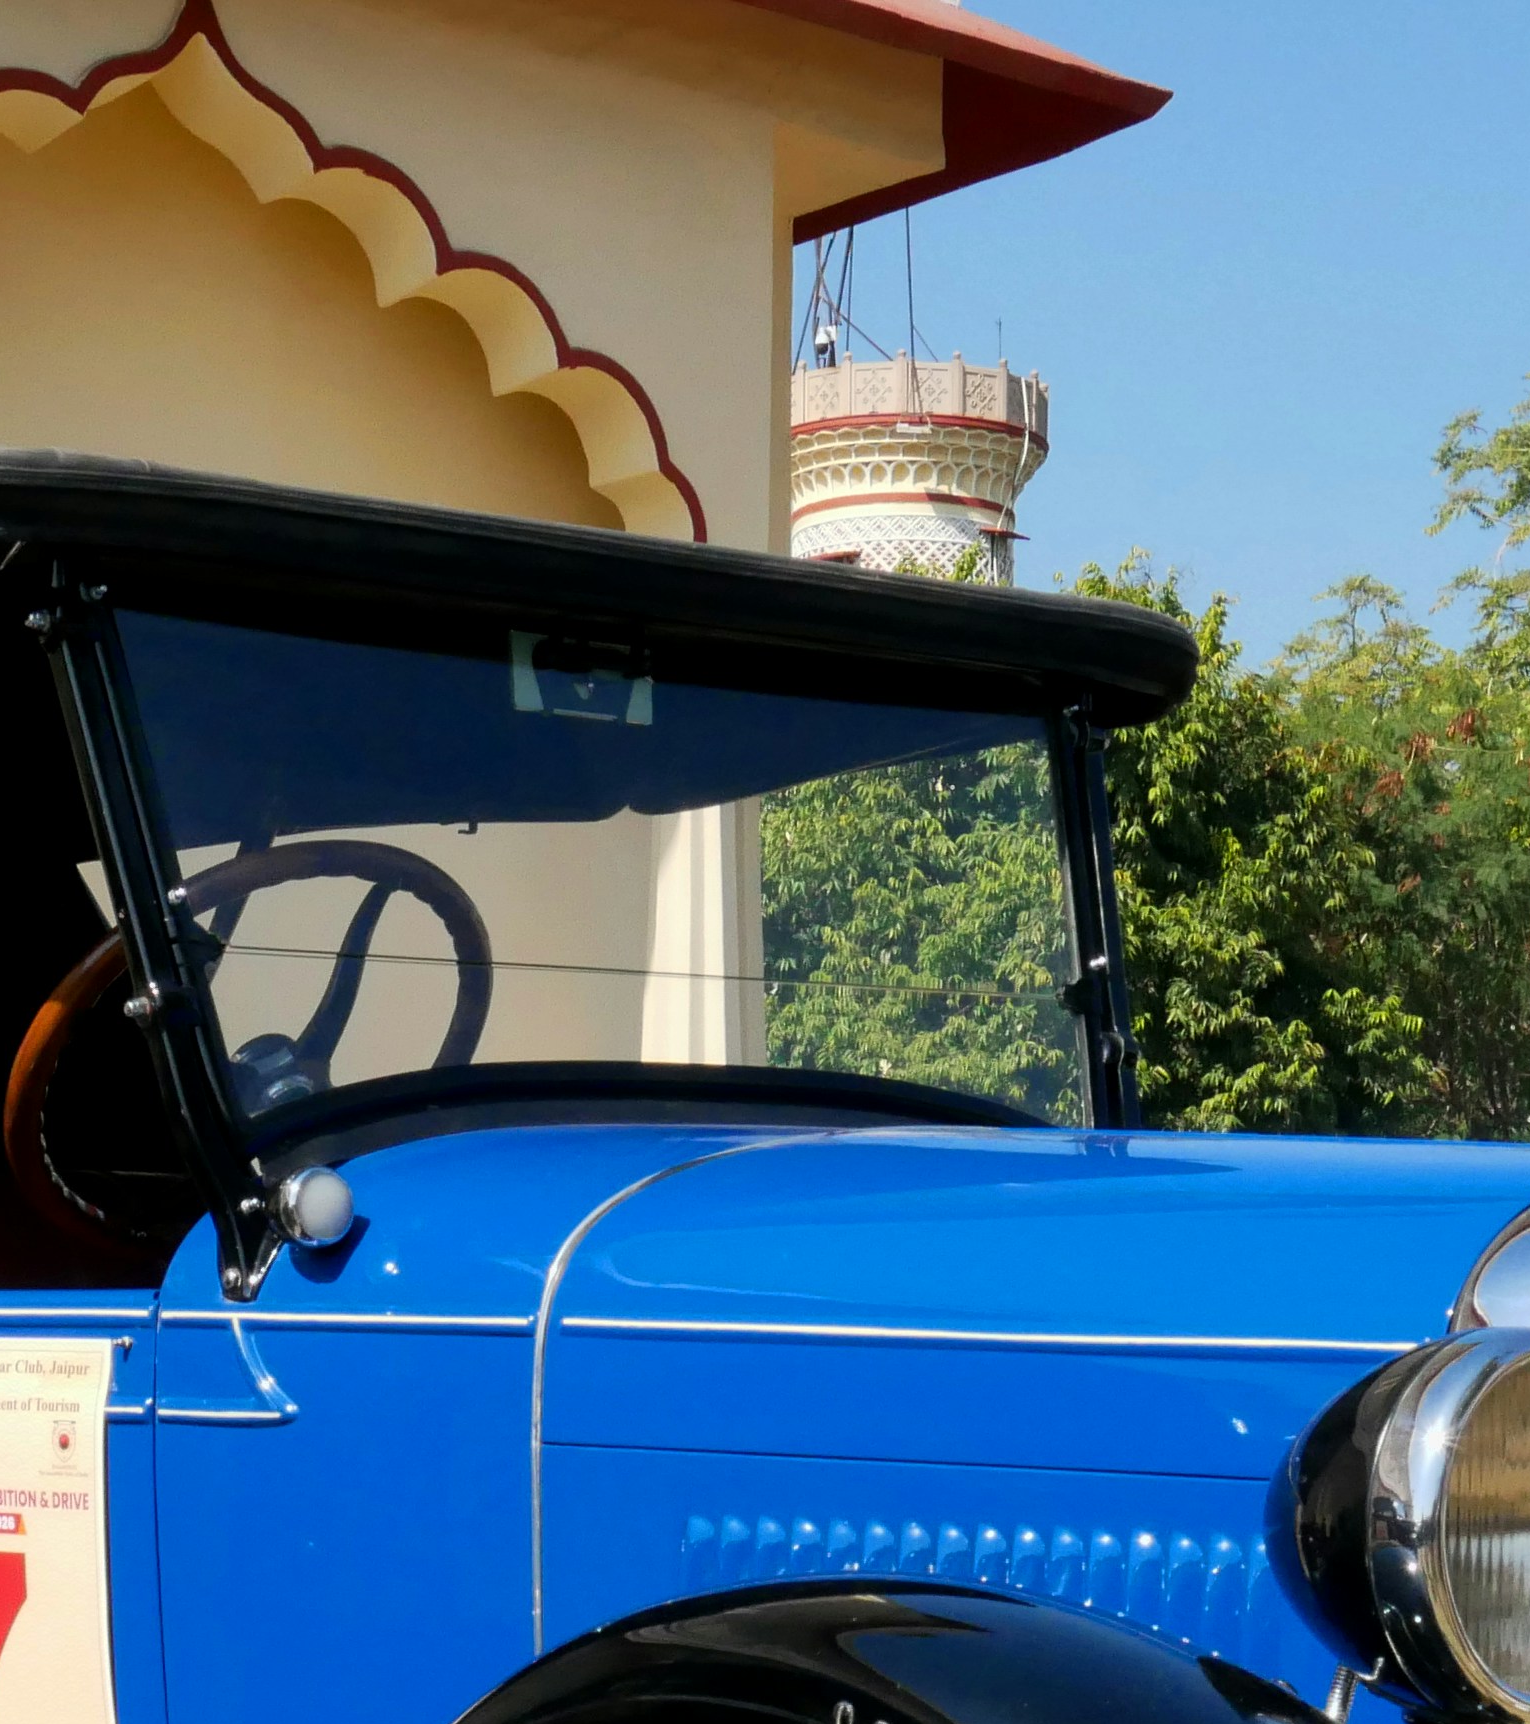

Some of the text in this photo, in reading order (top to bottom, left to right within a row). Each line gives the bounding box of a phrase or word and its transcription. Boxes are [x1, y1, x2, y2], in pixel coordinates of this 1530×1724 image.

[15, 1359, 46, 1375] Club,
[49, 1360, 91, 1379] Jaipur
[20, 1397, 33, 1411] of
[34, 1397, 80, 1412] Tourism
[40, 1491, 49, 1508] &
[52, 1491, 89, 1511] DRIVE
